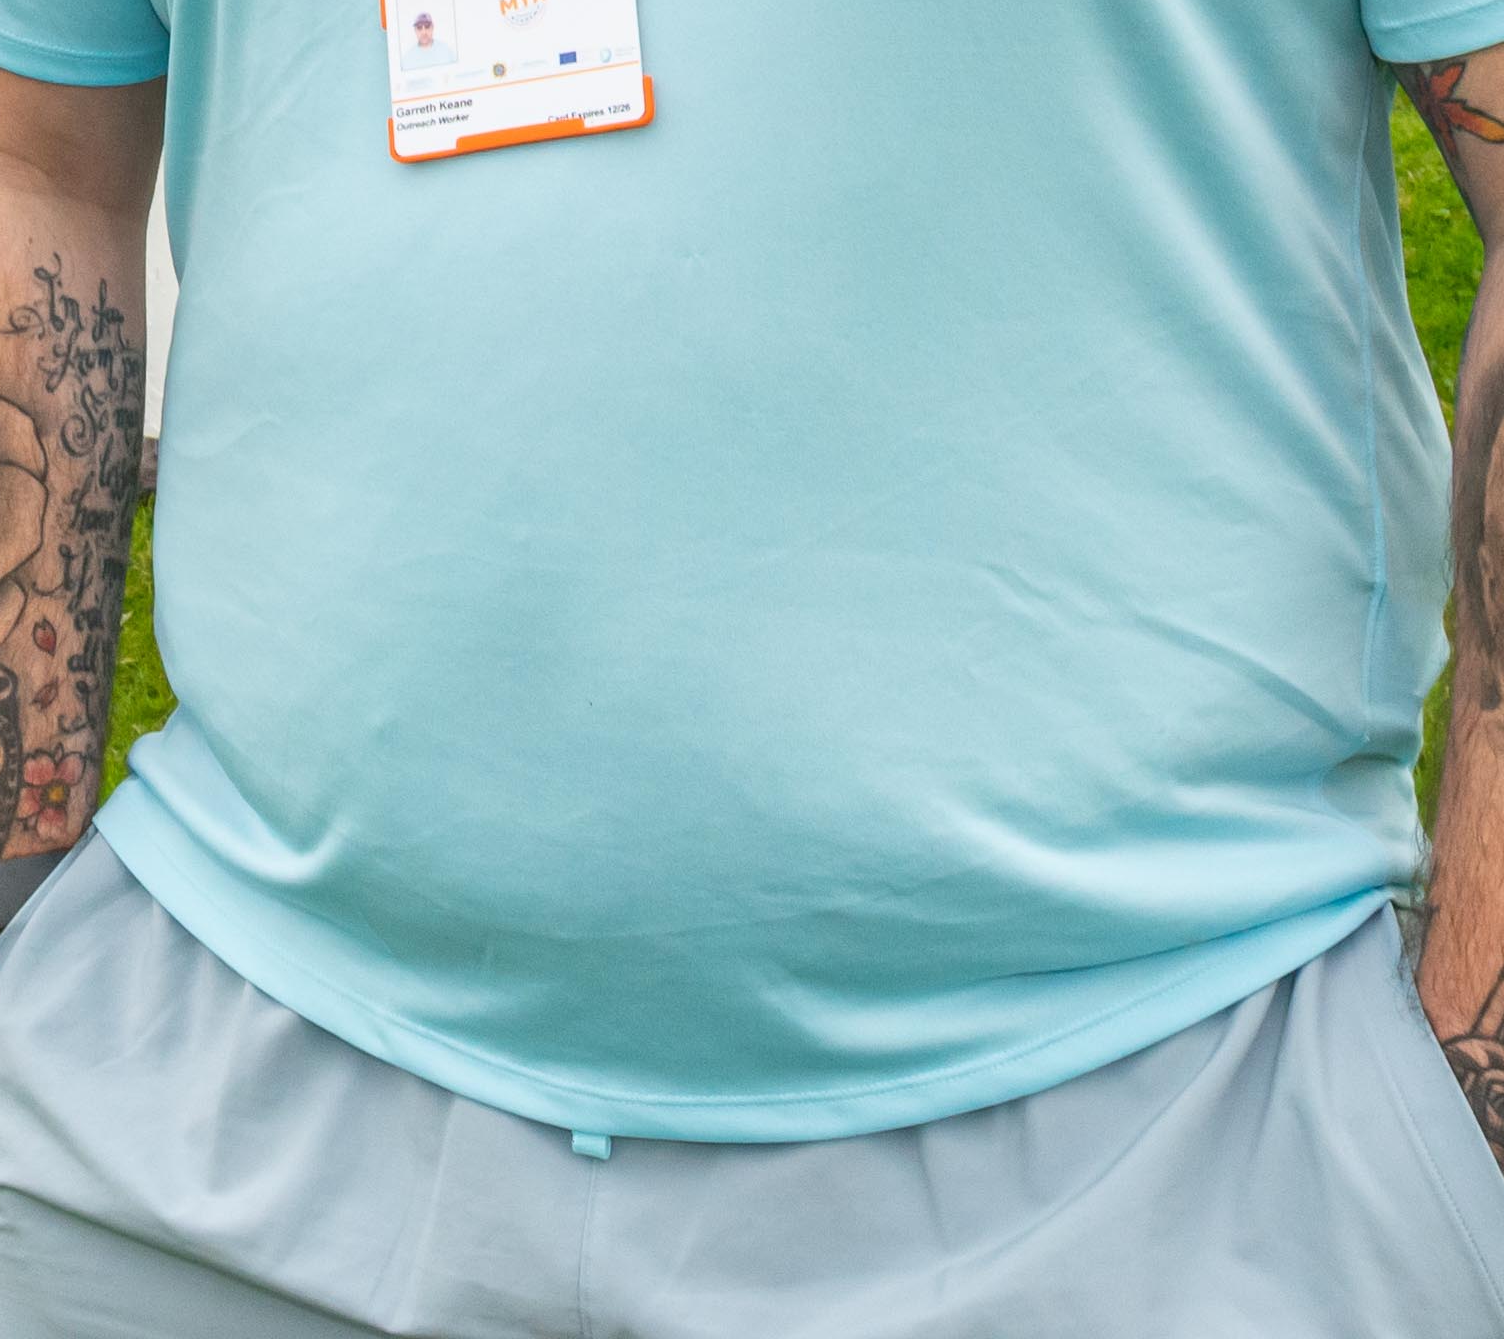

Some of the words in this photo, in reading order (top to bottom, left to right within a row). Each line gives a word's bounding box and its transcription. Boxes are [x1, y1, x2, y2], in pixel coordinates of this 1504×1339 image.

[439, 98, 473, 111] Keane
[396, 119, 436, 132] Outreach
[439, 113, 470, 125] Worker
